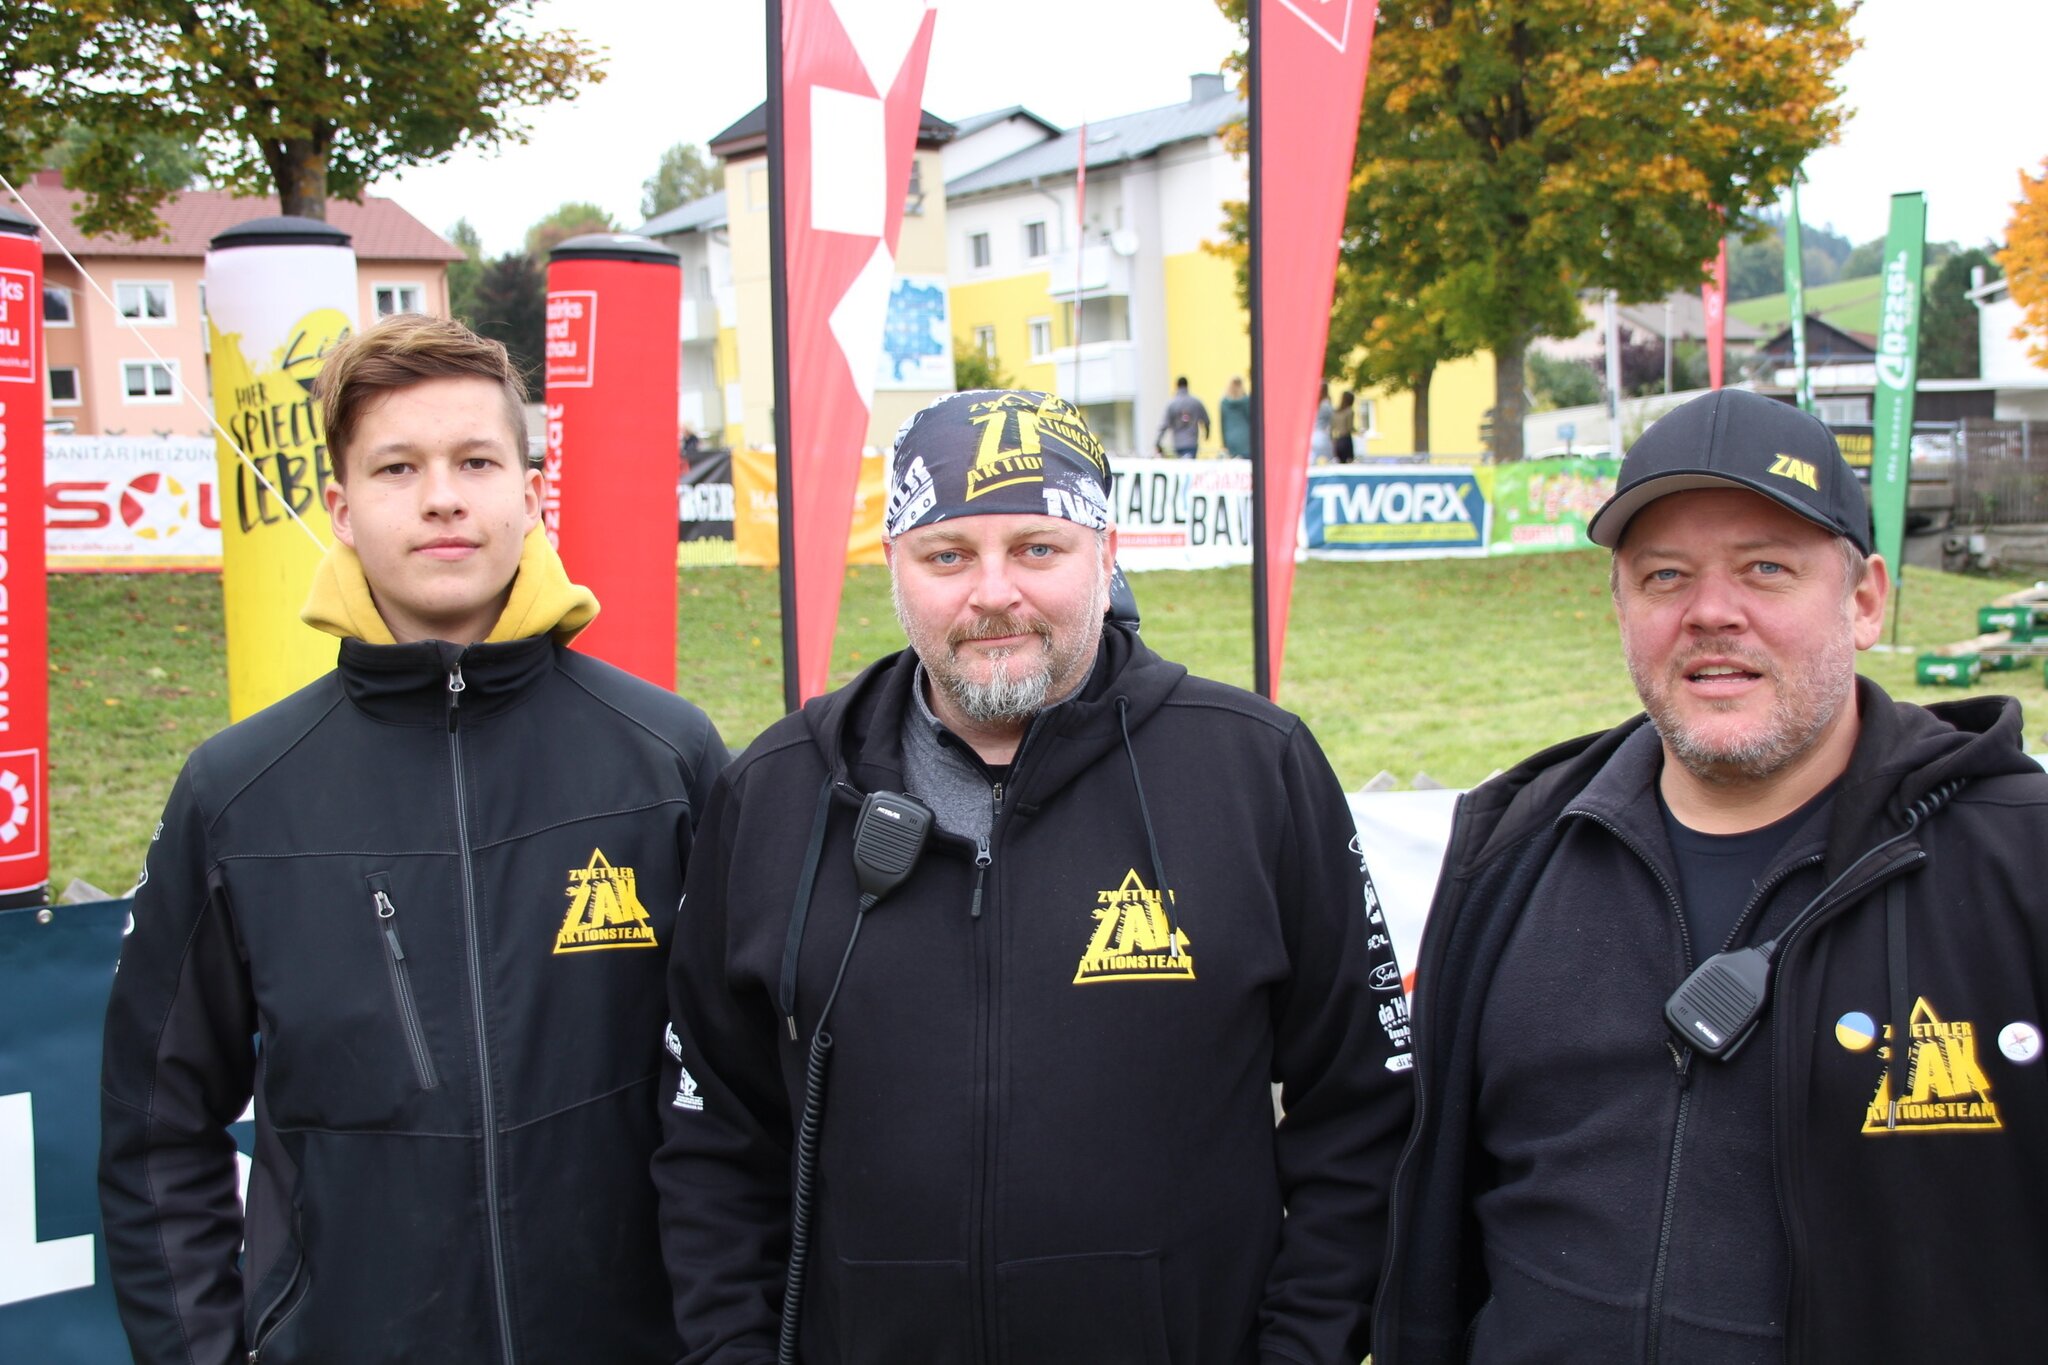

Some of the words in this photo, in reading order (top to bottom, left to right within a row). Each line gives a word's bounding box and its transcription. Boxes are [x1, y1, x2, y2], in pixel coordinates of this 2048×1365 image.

[235, 382, 268, 409] HIER
[1766, 453, 1818, 491] ZAK
[1312, 481, 1473, 524] TWORX
[565, 879, 650, 932] ZAK
[559, 927, 655, 944] AKTIONSTEAM
[1079, 955, 1193, 972] AKTIONSTEAM
